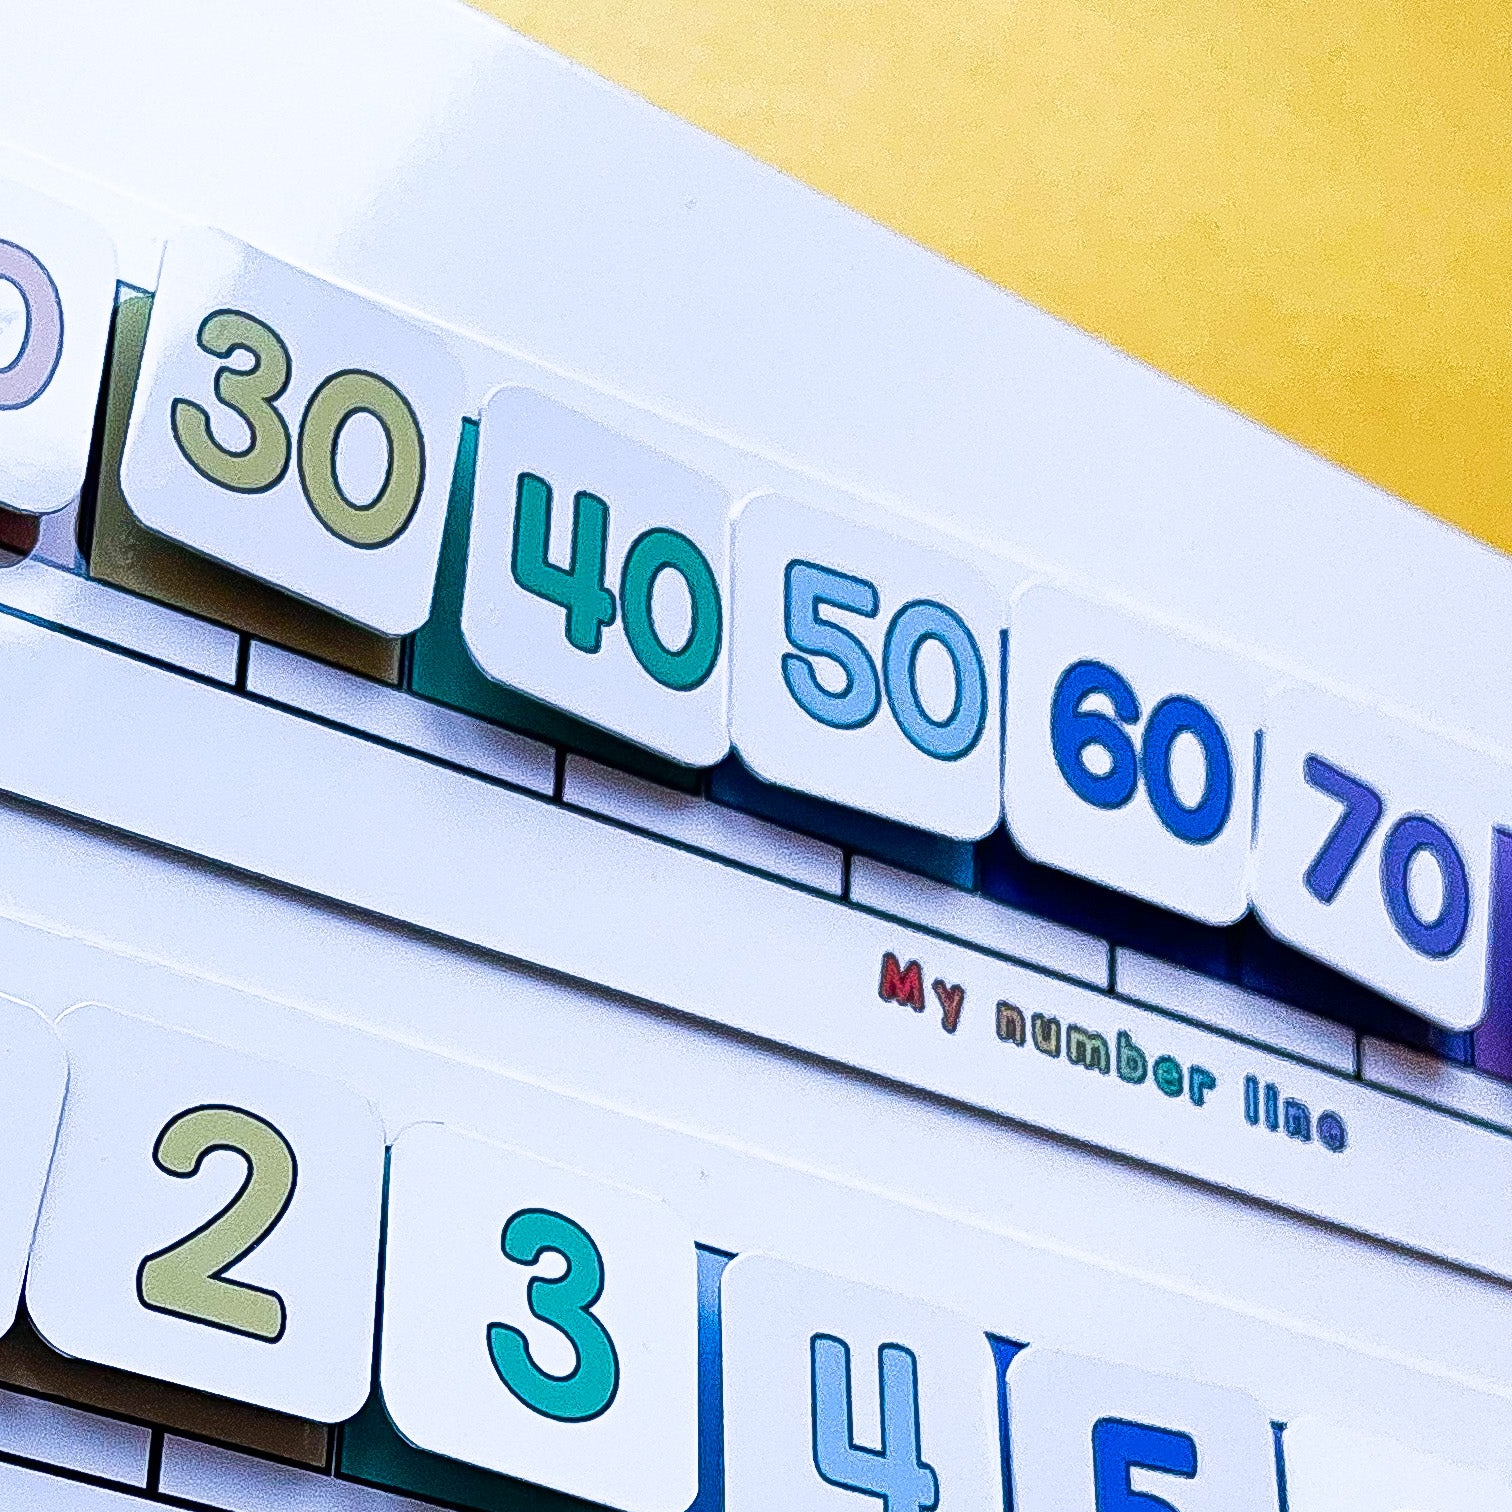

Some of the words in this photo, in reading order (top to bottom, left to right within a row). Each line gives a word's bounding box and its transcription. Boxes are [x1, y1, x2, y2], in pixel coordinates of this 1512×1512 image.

[170, 308, 426, 550] 30
[511, 472, 723, 692] 40
[783, 559, 988, 762] 50
[1050, 659, 1235, 846] 60
[1303, 753, 1472, 961] 70
[879, 952, 966, 1033] My
[996, 1000, 1216, 1106] number
[1244, 1074, 1347, 1153] line
[136, 1104, 298, 1344] 2
[486, 1208, 620, 1423] 3
